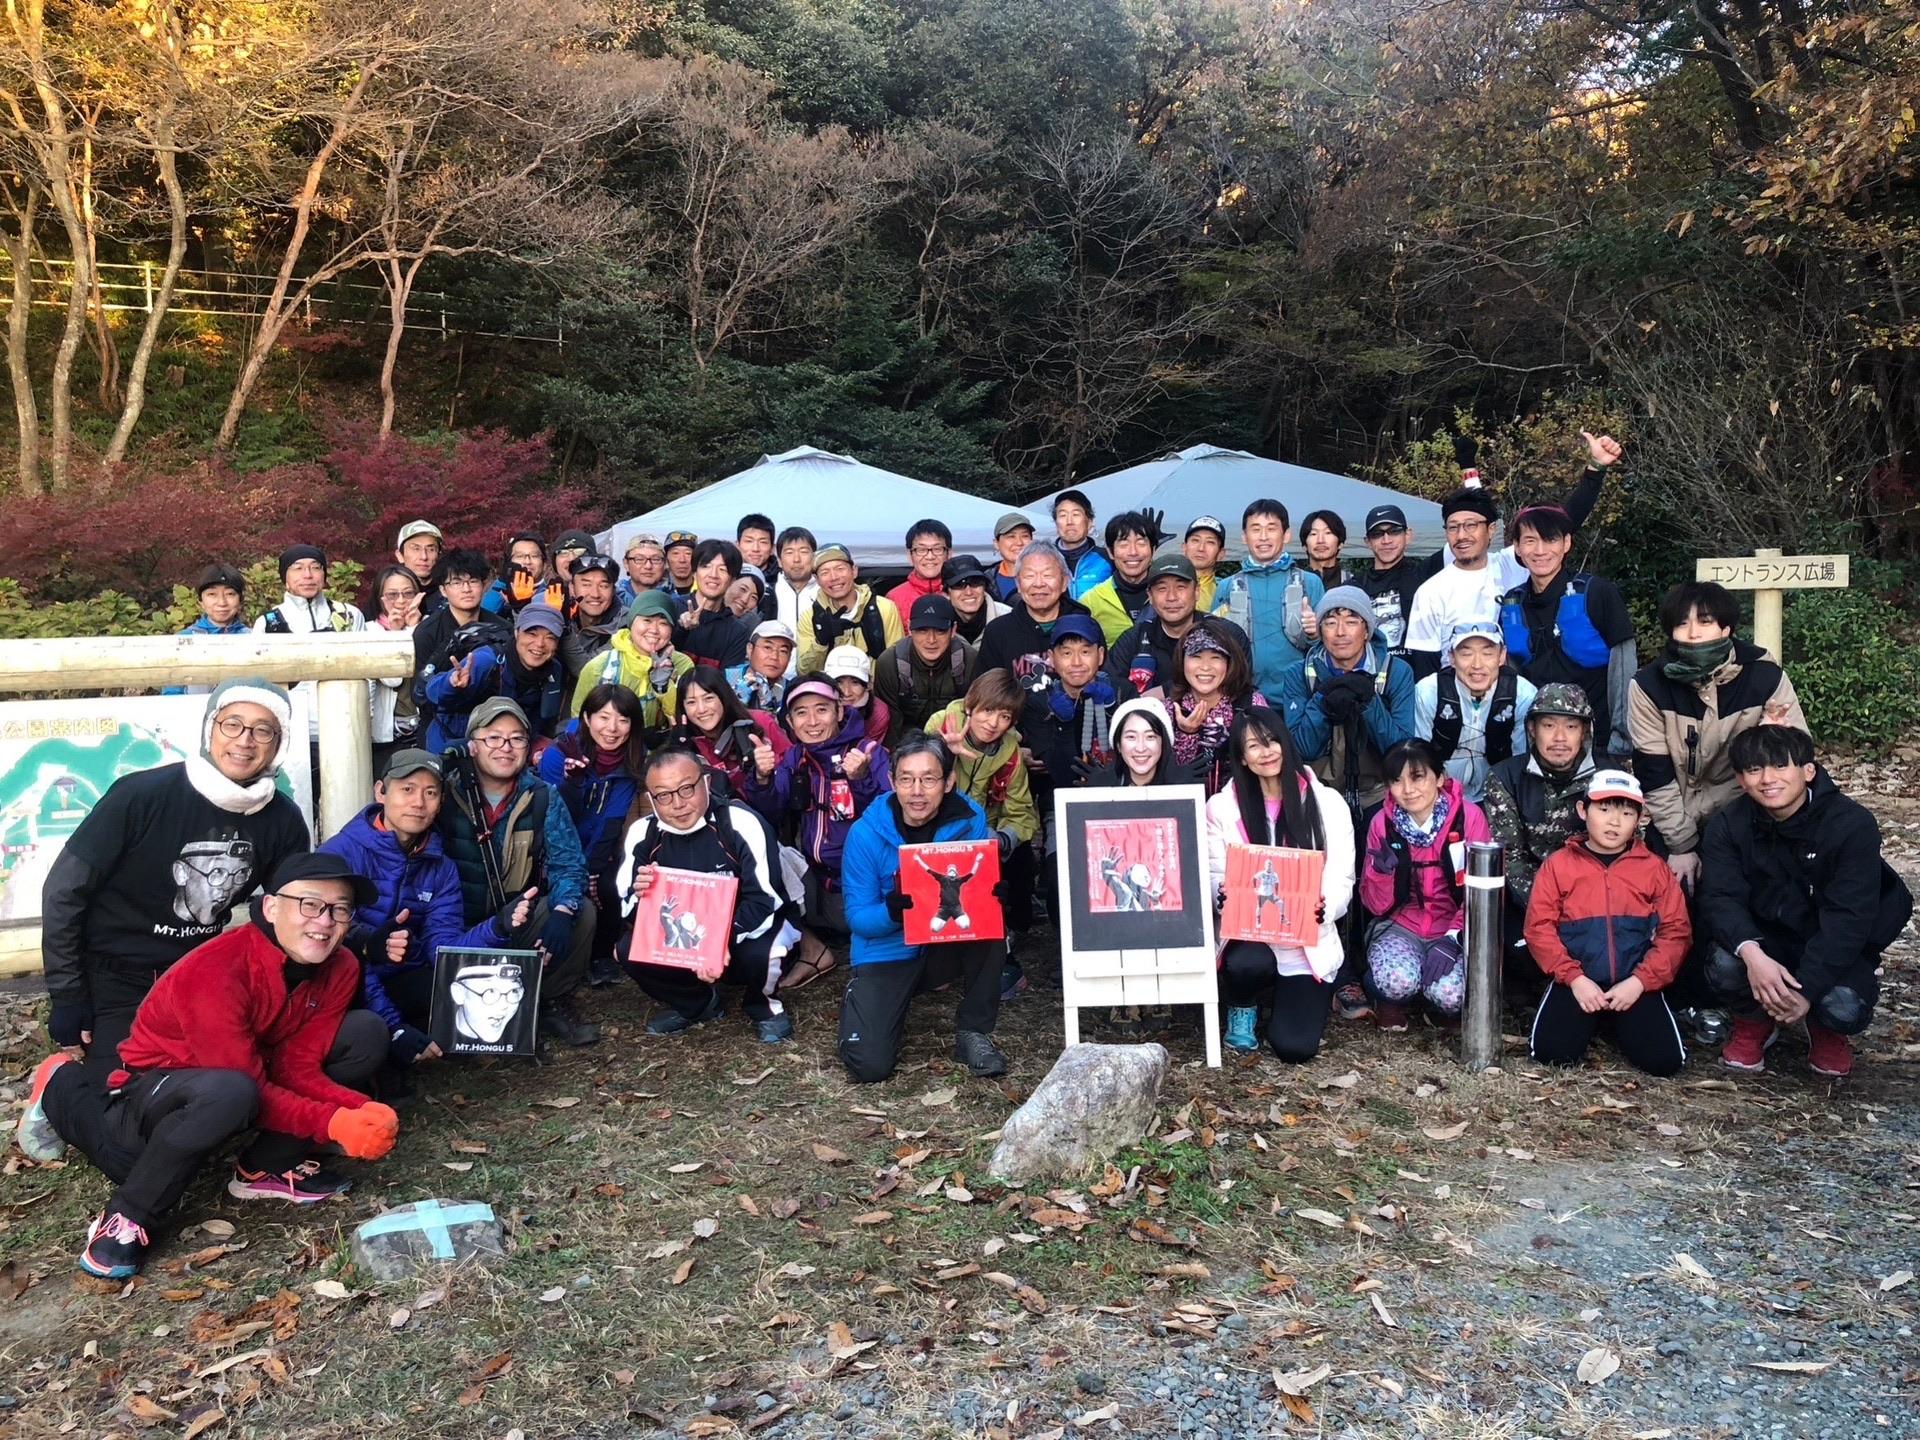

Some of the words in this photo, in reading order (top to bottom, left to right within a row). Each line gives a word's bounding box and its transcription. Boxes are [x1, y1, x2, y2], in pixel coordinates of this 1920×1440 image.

[1710, 561, 1835, 583] エントランス広場
[0, 717, 118, 739] 公園案内図
[455, 1043, 505, 1052] MT.HONGU
[506, 1044, 514, 1052] 5
